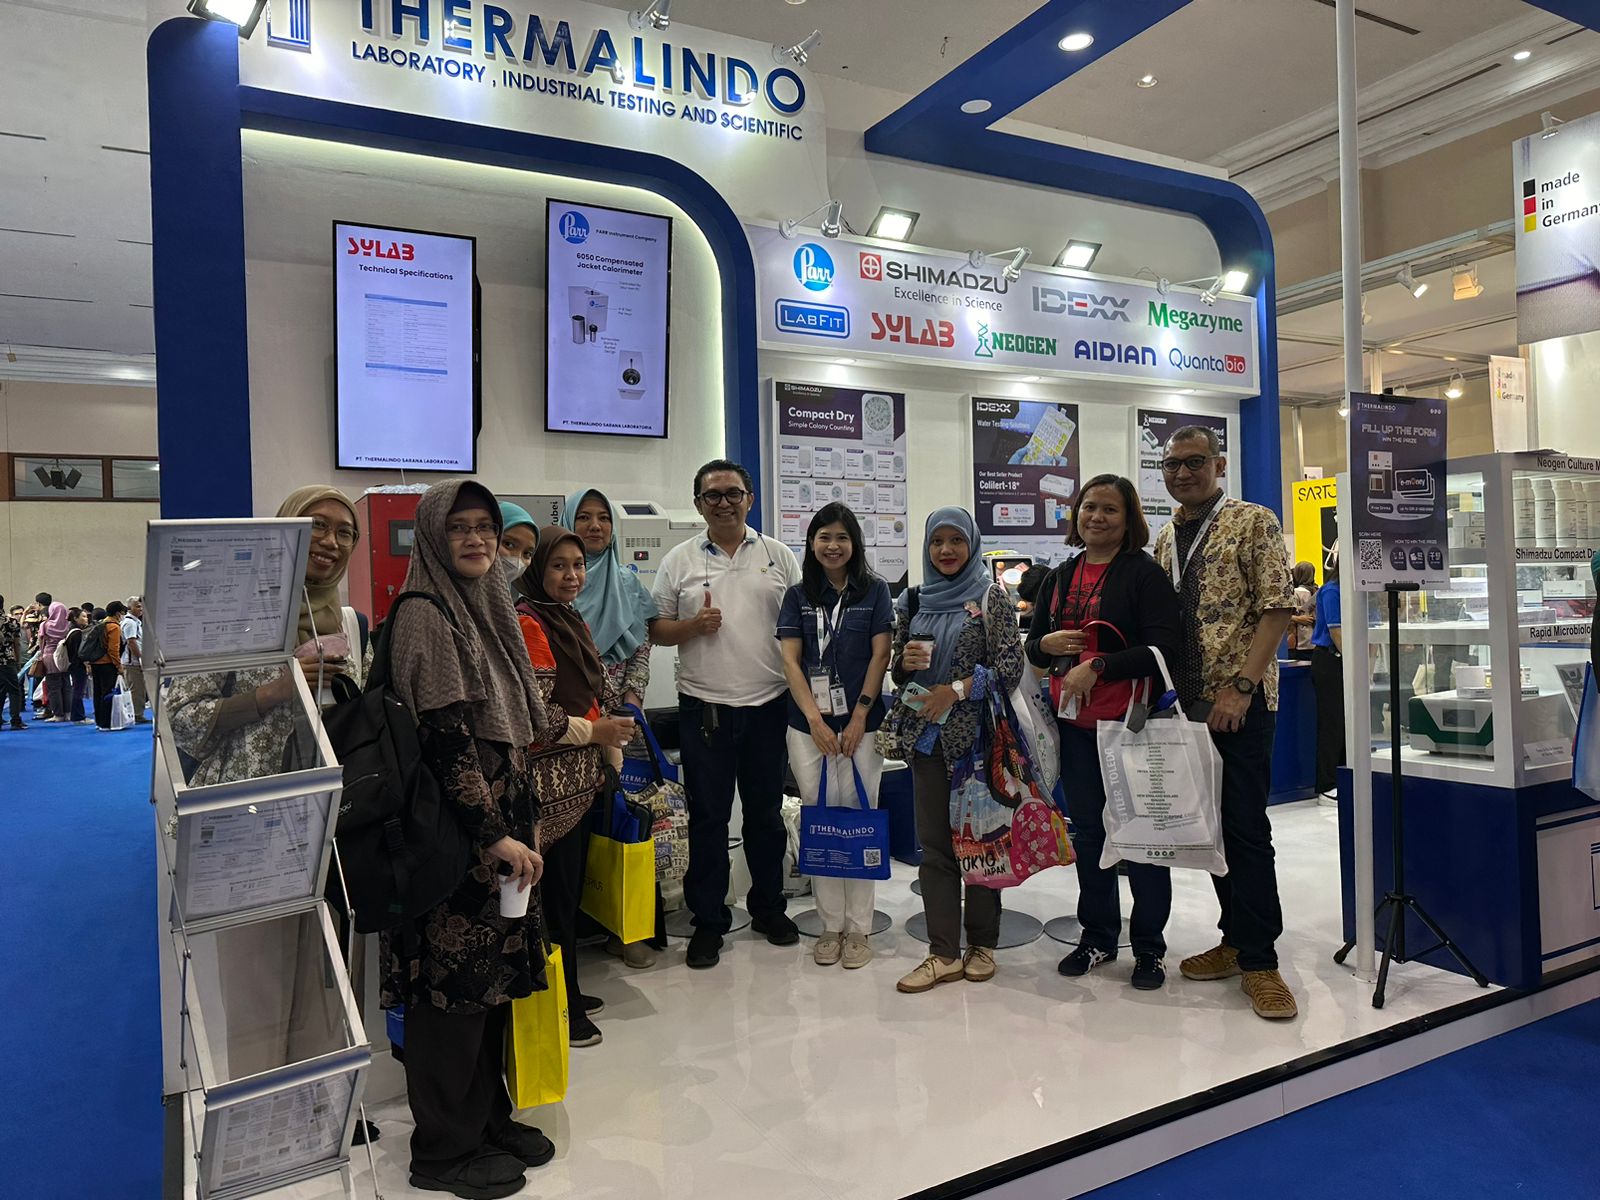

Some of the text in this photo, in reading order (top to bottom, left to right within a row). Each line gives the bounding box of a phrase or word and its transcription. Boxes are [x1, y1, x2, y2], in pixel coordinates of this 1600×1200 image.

[352, 41, 486, 83] LABORATORY
[502, 69, 605, 106] INDUSTRIAL
[609, 90, 677, 117] TESTING
[681, 105, 717, 126] AND
[721, 112, 803, 141] SCIENTIFIC
[1541, 172, 1580, 193] made
[1541, 198, 1554, 211] in
[562, 213, 588, 239] Parr
[347, 237, 415, 261] SYLAB
[576, 252, 644, 268] 6050 Compensated
[798, 245, 833, 285] Parr
[359, 264, 454, 281] Technical Specifications
[577, 262, 643, 276] Jacket Calorimeter
[886, 261, 1009, 295] SHIMADZU
[894, 286, 1003, 312] Excellence in Science
[1032, 286, 1130, 323] IDEXX
[1148, 301, 1243, 334] Megazyme
[871, 312, 956, 348] SYLAB
[991, 331, 1057, 356] NEOGEN
[1074, 339, 1157, 367] AIDIAN
[1169, 348, 1246, 374] Quantabio
[788, 406, 855, 423] Compact Dry
[976, 401, 1011, 413] IDEXX
[1361, 402, 1397, 411] THERMALINDO
[788, 421, 855, 433] Simple Colony Counting
[977, 420, 991, 428] Water
[1361, 423, 1437, 437] FILL UP THE FORM
[1537, 456, 1566, 471] Neogen
[1567, 458, 1593, 471] Culture
[1516, 548, 1597, 561] Shimadzu Compact Dr
[1530, 625, 1592, 640] Rapid Microbiolo
[620, 774, 648, 784] HERMA
[1113, 789, 1129, 824] ETTLER
[817, 825, 875, 836] THERMALINDO
[982, 863, 1006, 877] JAPAN
